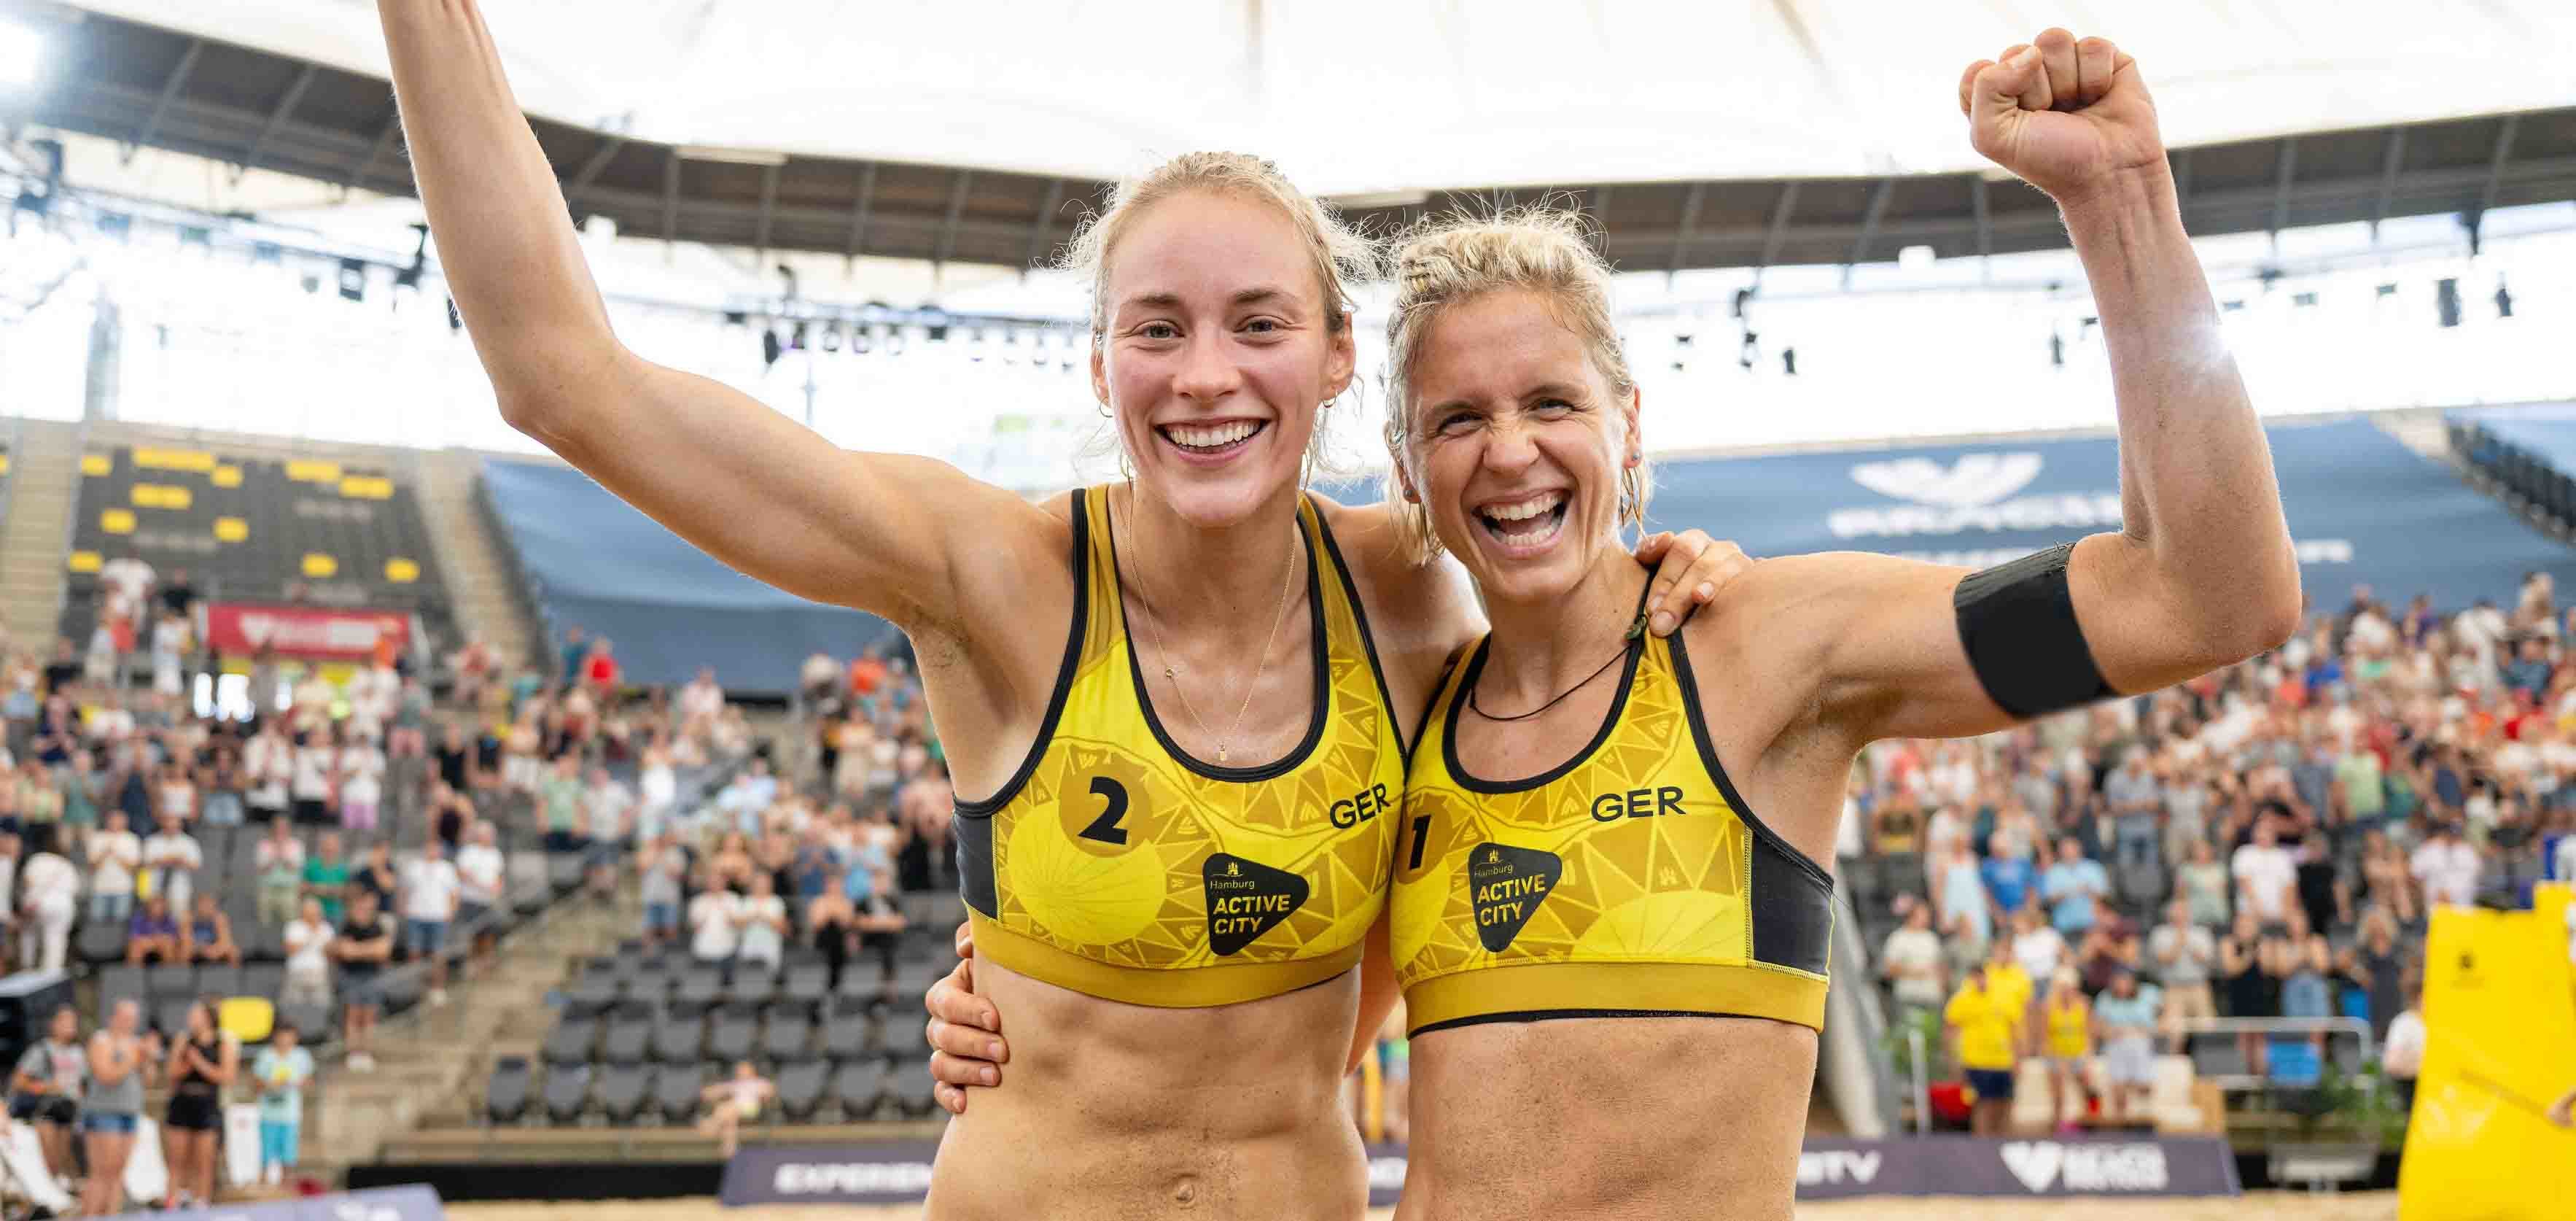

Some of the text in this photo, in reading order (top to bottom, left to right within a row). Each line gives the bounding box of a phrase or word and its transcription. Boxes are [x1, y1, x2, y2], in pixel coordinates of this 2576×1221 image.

[1077, 776, 1129, 845] 2
[1329, 783, 1391, 829] GER
[1591, 786, 1686, 822] GER
[1409, 815, 1431, 870] 1
[1474, 863, 1514, 877] Hamburg
[1210, 880, 1255, 890] Hamburg
[1477, 874, 1546, 904] ACTIVE
[1213, 894, 1291, 915] ACTIVE
[1480, 901, 1523, 926] CITY
[1214, 917, 1263, 934] CITY
